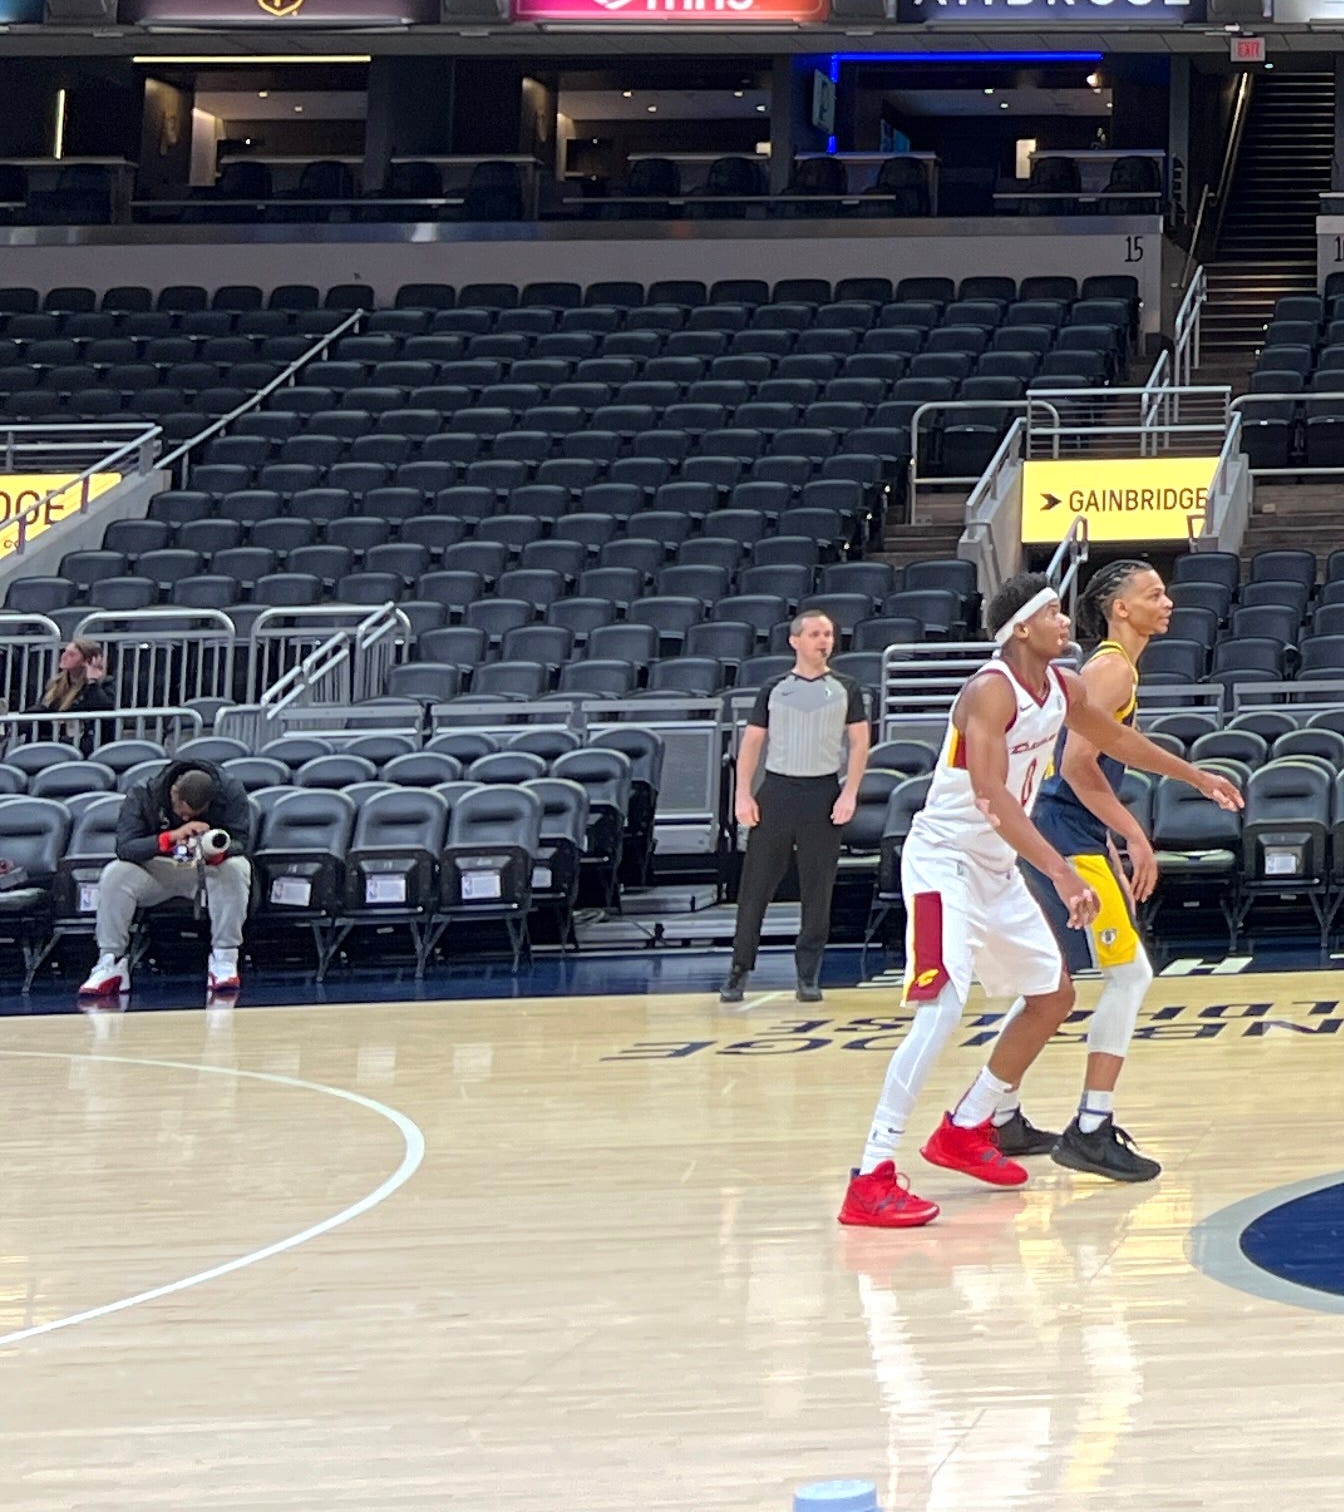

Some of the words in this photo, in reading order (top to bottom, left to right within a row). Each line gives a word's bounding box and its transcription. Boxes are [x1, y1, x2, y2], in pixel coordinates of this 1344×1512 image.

[1236, 40, 1260, 58] EXIT
[1125, 236, 1143, 263] 15
[1069, 488, 1209, 513] GAINBRIDGE
